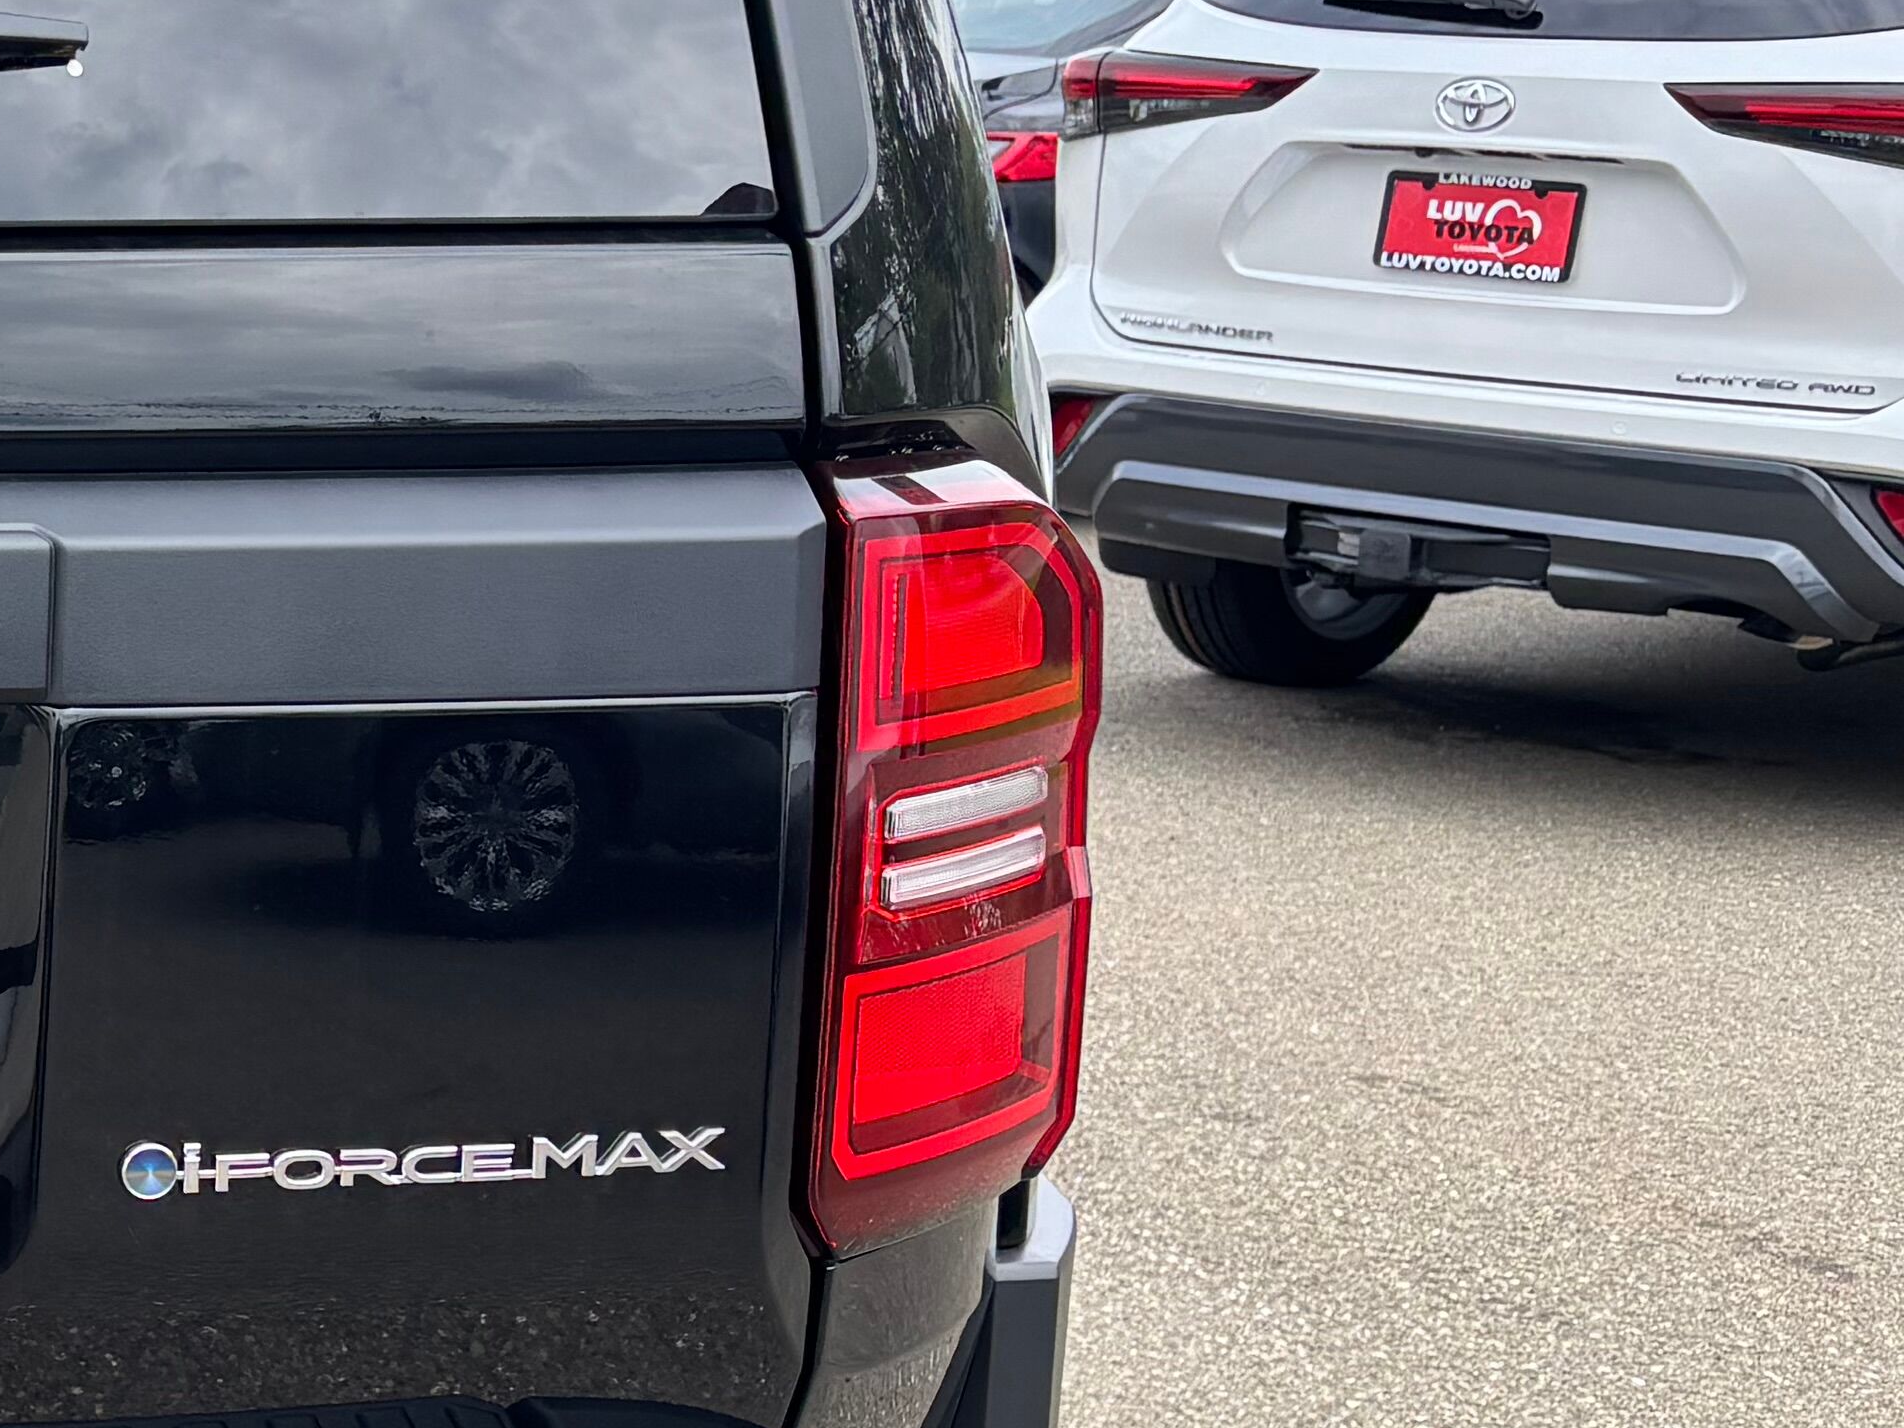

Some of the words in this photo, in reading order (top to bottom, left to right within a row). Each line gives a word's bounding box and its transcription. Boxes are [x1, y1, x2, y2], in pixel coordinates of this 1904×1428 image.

[1439, 173, 1532, 190] LAKEWOOD
[1426, 198, 1485, 223] LUV
[1433, 220, 1535, 245] TOYOTA
[1380, 251, 1561, 283] LUVTOYOTA.COM
[1808, 382, 1876, 396] AWD
